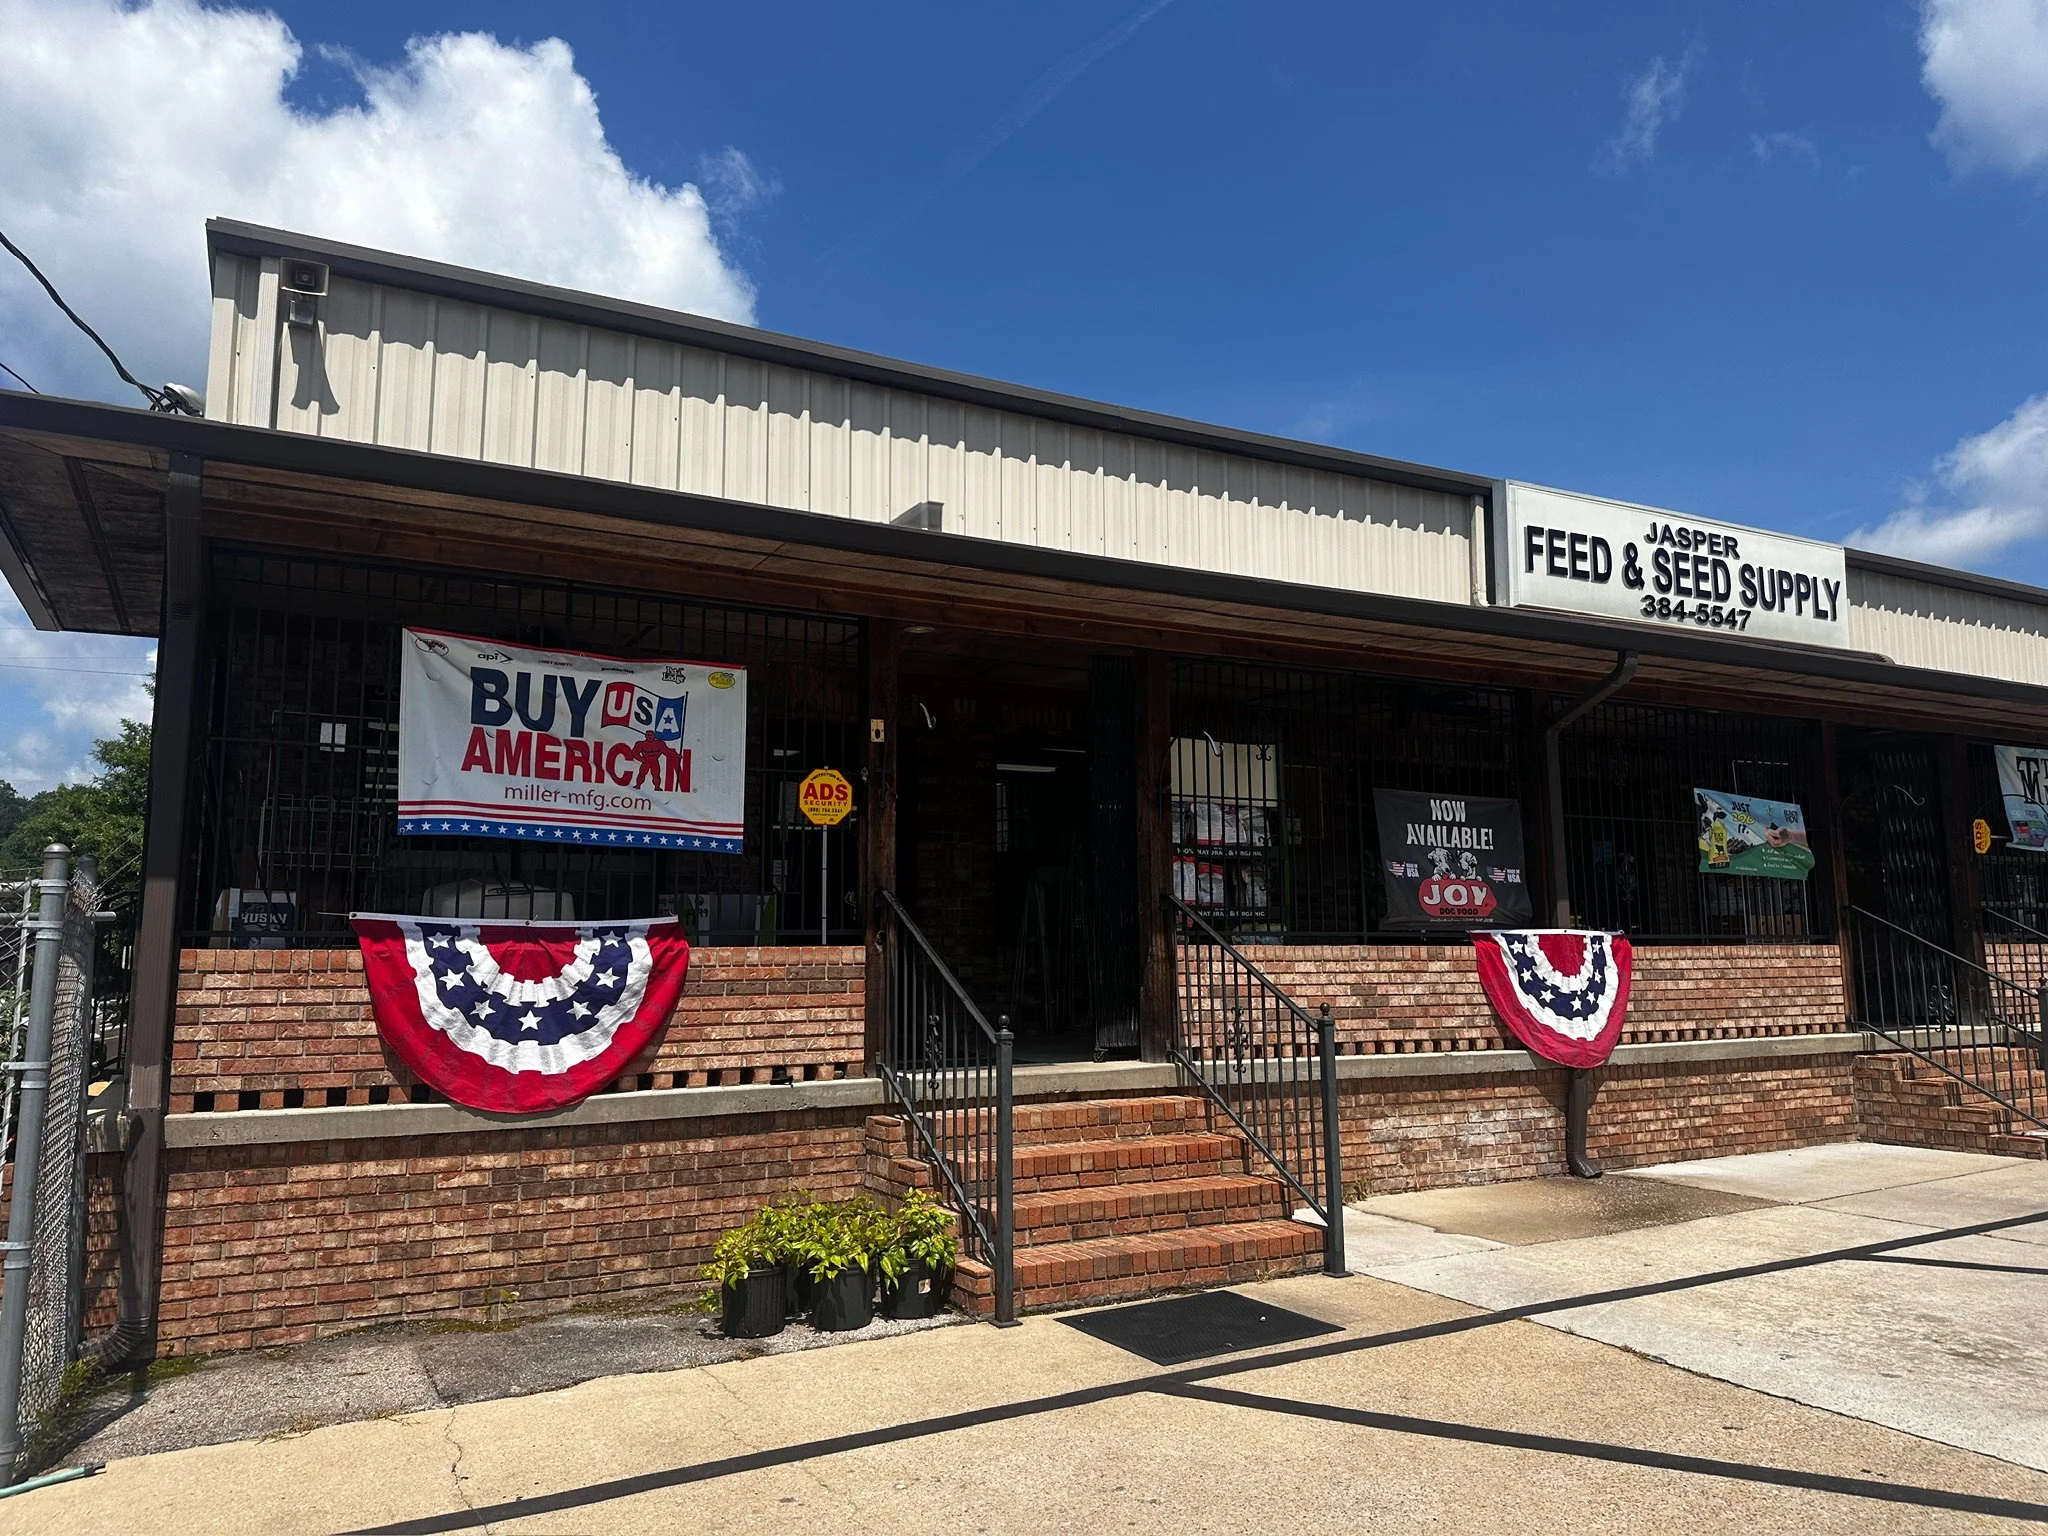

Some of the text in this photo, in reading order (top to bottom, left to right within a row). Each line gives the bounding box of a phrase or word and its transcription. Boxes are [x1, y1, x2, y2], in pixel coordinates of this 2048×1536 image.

[1644, 522, 1740, 559] JASPER
[1524, 525, 1841, 622] FEED & SEED SUPPLY
[1640, 594, 1752, 631] 384-5547
[477, 653, 499, 661] api
[470, 666, 603, 738] BUY
[607, 686, 680, 734] USA
[504, 785, 652, 811] miller-mfg.com
[803, 782, 848, 801] ADS
[1430, 799, 1466, 823] NOW
[1731, 800, 1751, 814] JUST
[1406, 824, 1494, 850] AVAILABLE!
[1407, 868, 1419, 877] USA
[1507, 873, 1521, 883] USA
[1423, 884, 1488, 906] JOY
[242, 913, 287, 925] HUSKY
[1439, 907, 1456, 915] DOG
